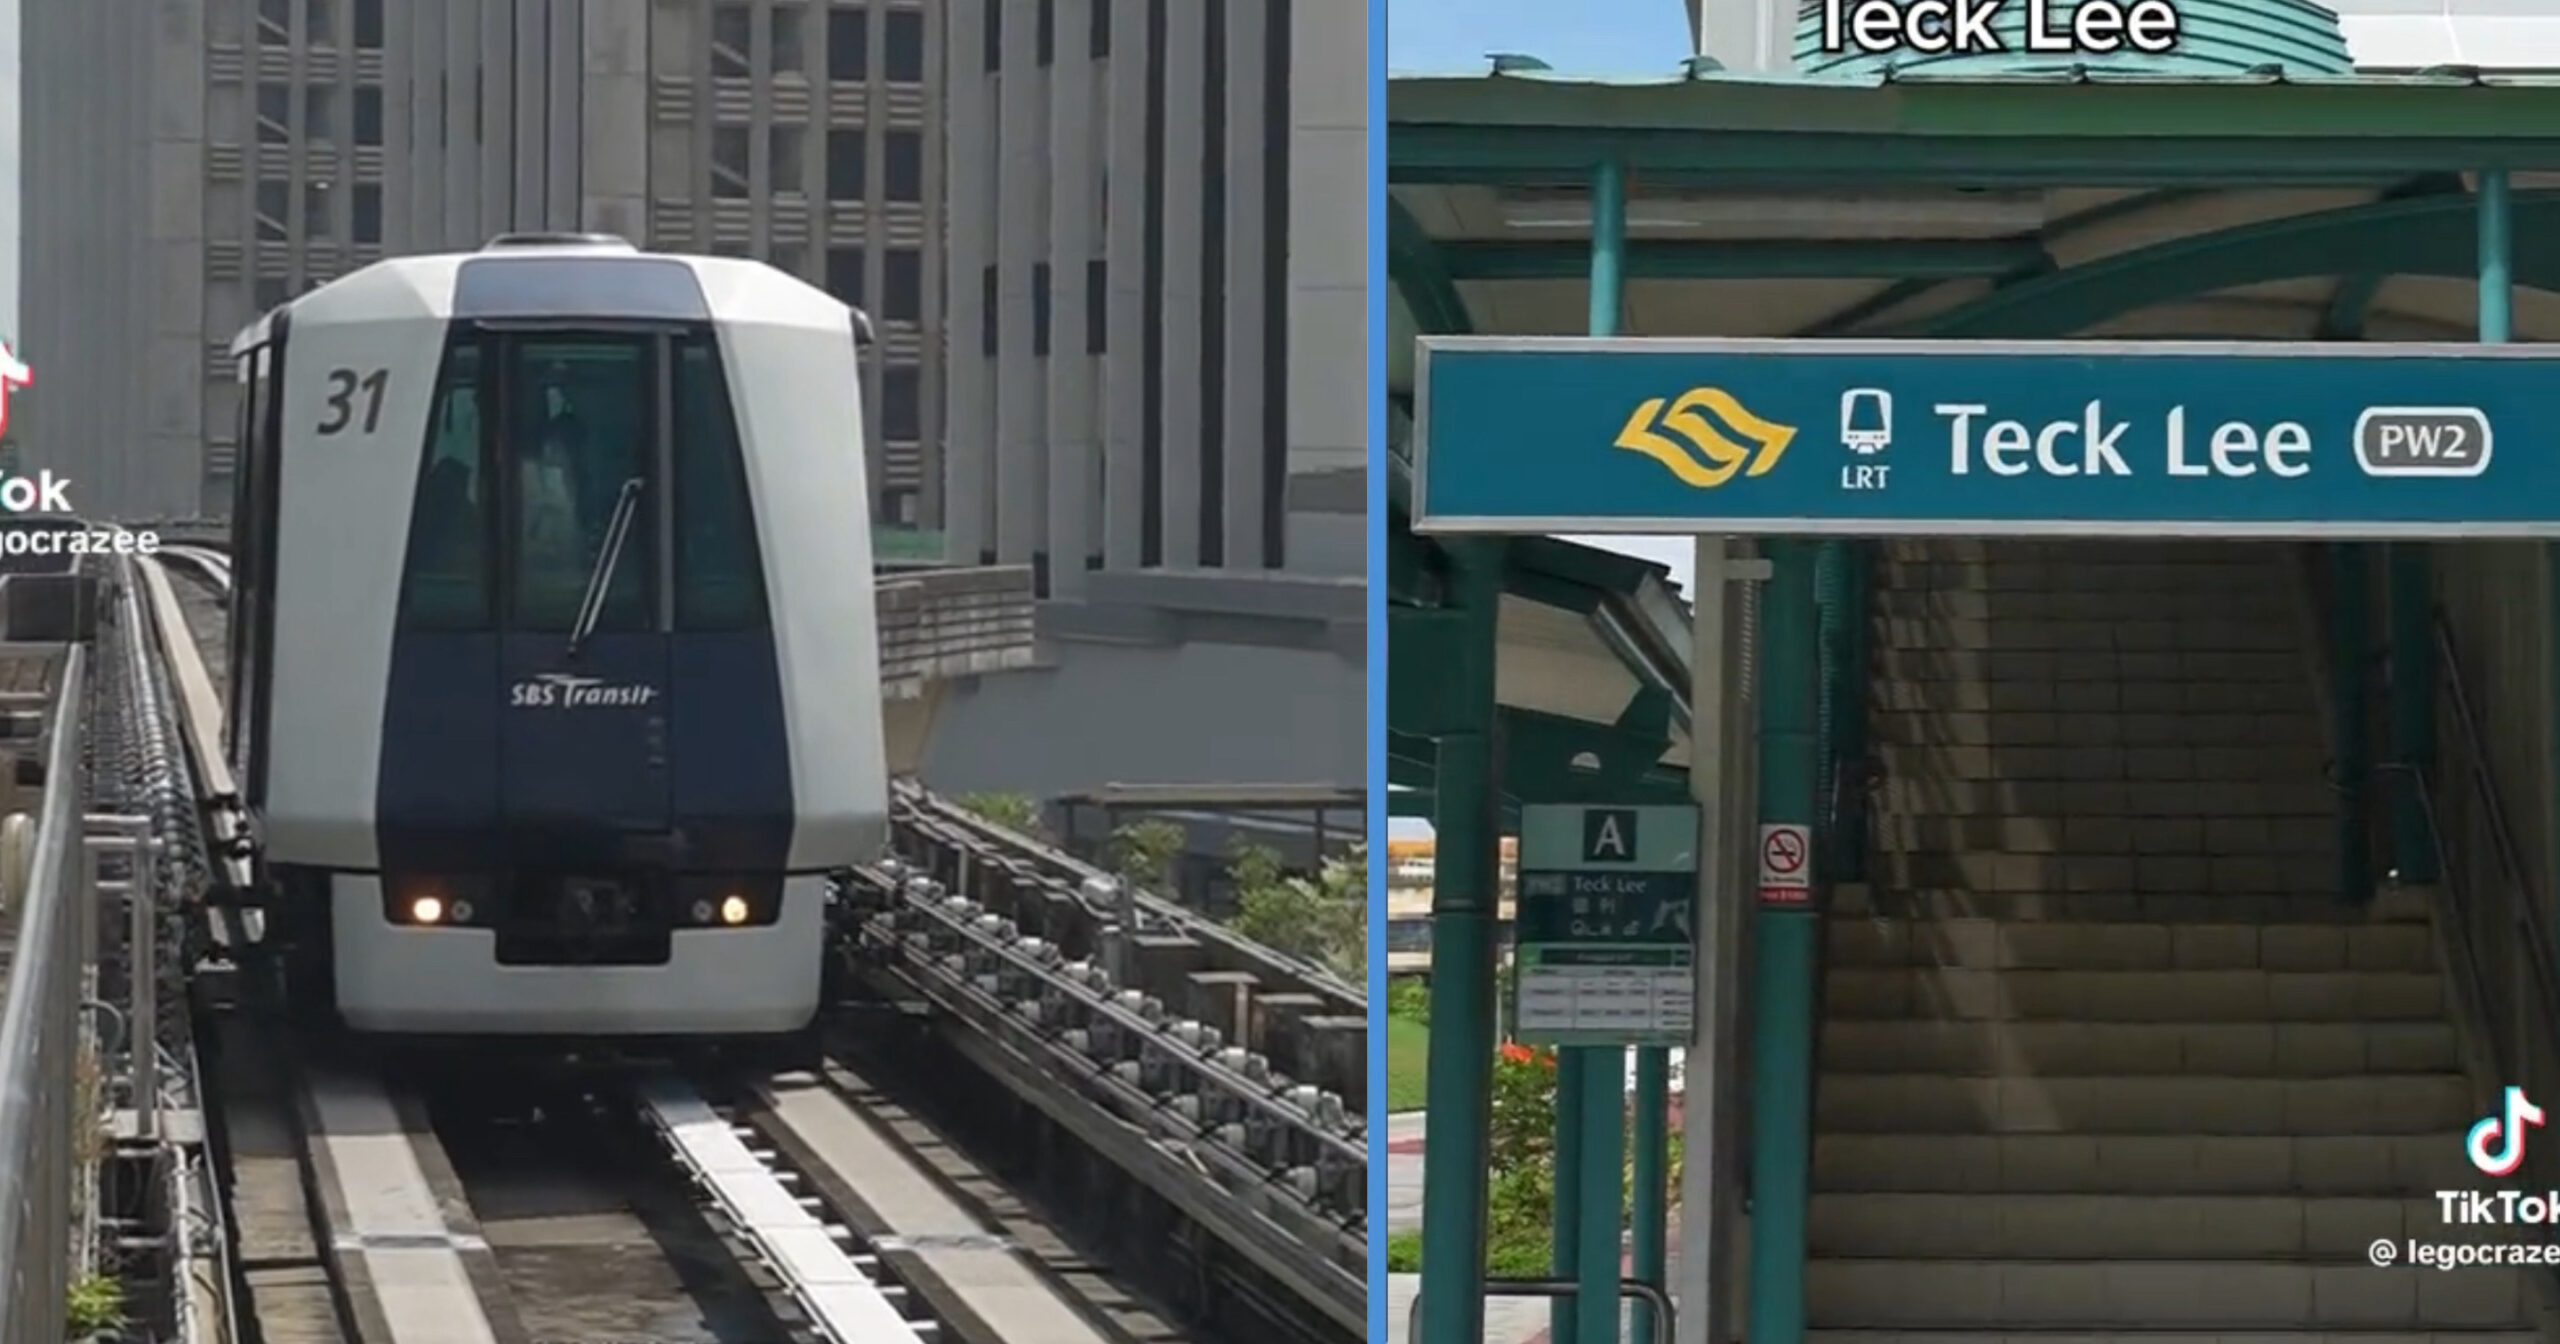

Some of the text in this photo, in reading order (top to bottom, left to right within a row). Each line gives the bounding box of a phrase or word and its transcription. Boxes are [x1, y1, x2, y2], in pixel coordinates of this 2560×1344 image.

[316, 368, 389, 436] 31
[1934, 399, 2468, 477] Teck Lee PW2
[1841, 465, 1891, 489] LRT
[511, 675, 660, 709] SBS Transit
[1593, 814, 1625, 856] A
[1574, 875, 1610, 892] Teck
[1616, 878, 1647, 893] Lee
